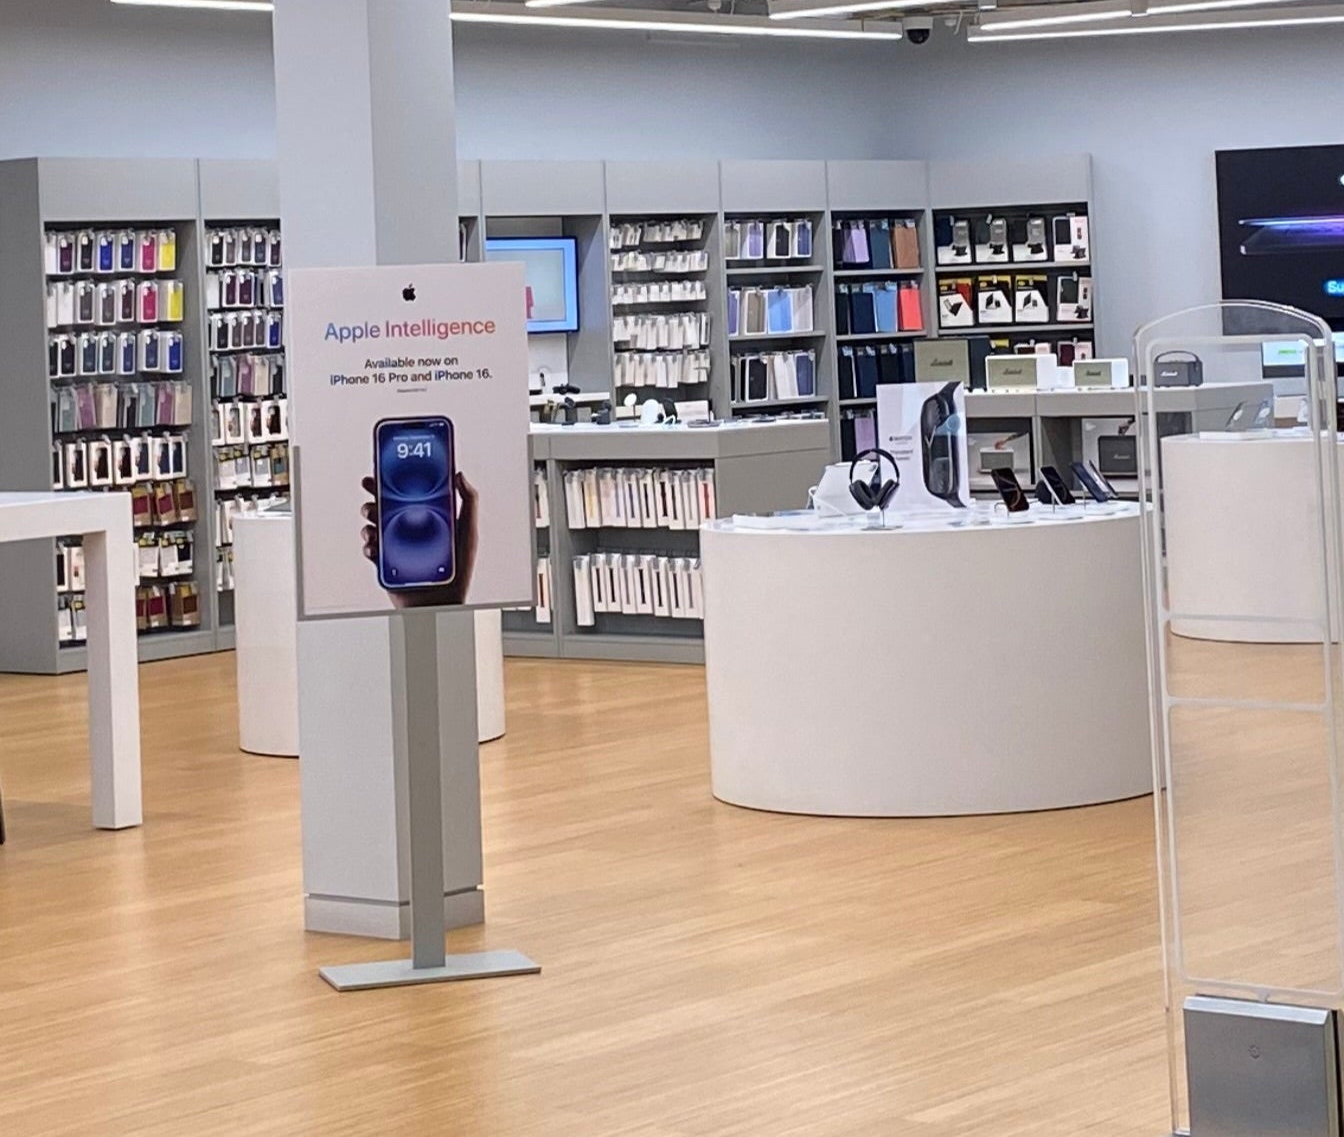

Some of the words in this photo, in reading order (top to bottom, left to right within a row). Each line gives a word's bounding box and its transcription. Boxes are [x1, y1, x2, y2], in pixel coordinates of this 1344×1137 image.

[324, 322, 380, 343] Apple
[385, 319, 496, 339] Intelligence
[364, 357, 415, 369] Available
[417, 358, 441, 367] now
[444, 357, 458, 366] on
[330, 374, 369, 385] iPhone
[373, 372, 385, 383] 16
[388, 372, 408, 383] Pro
[410, 370, 432, 382] and
[434, 369, 473, 381] iPhone
[476, 368, 492, 380] 16.
[397, 442, 432, 459] 9:41
